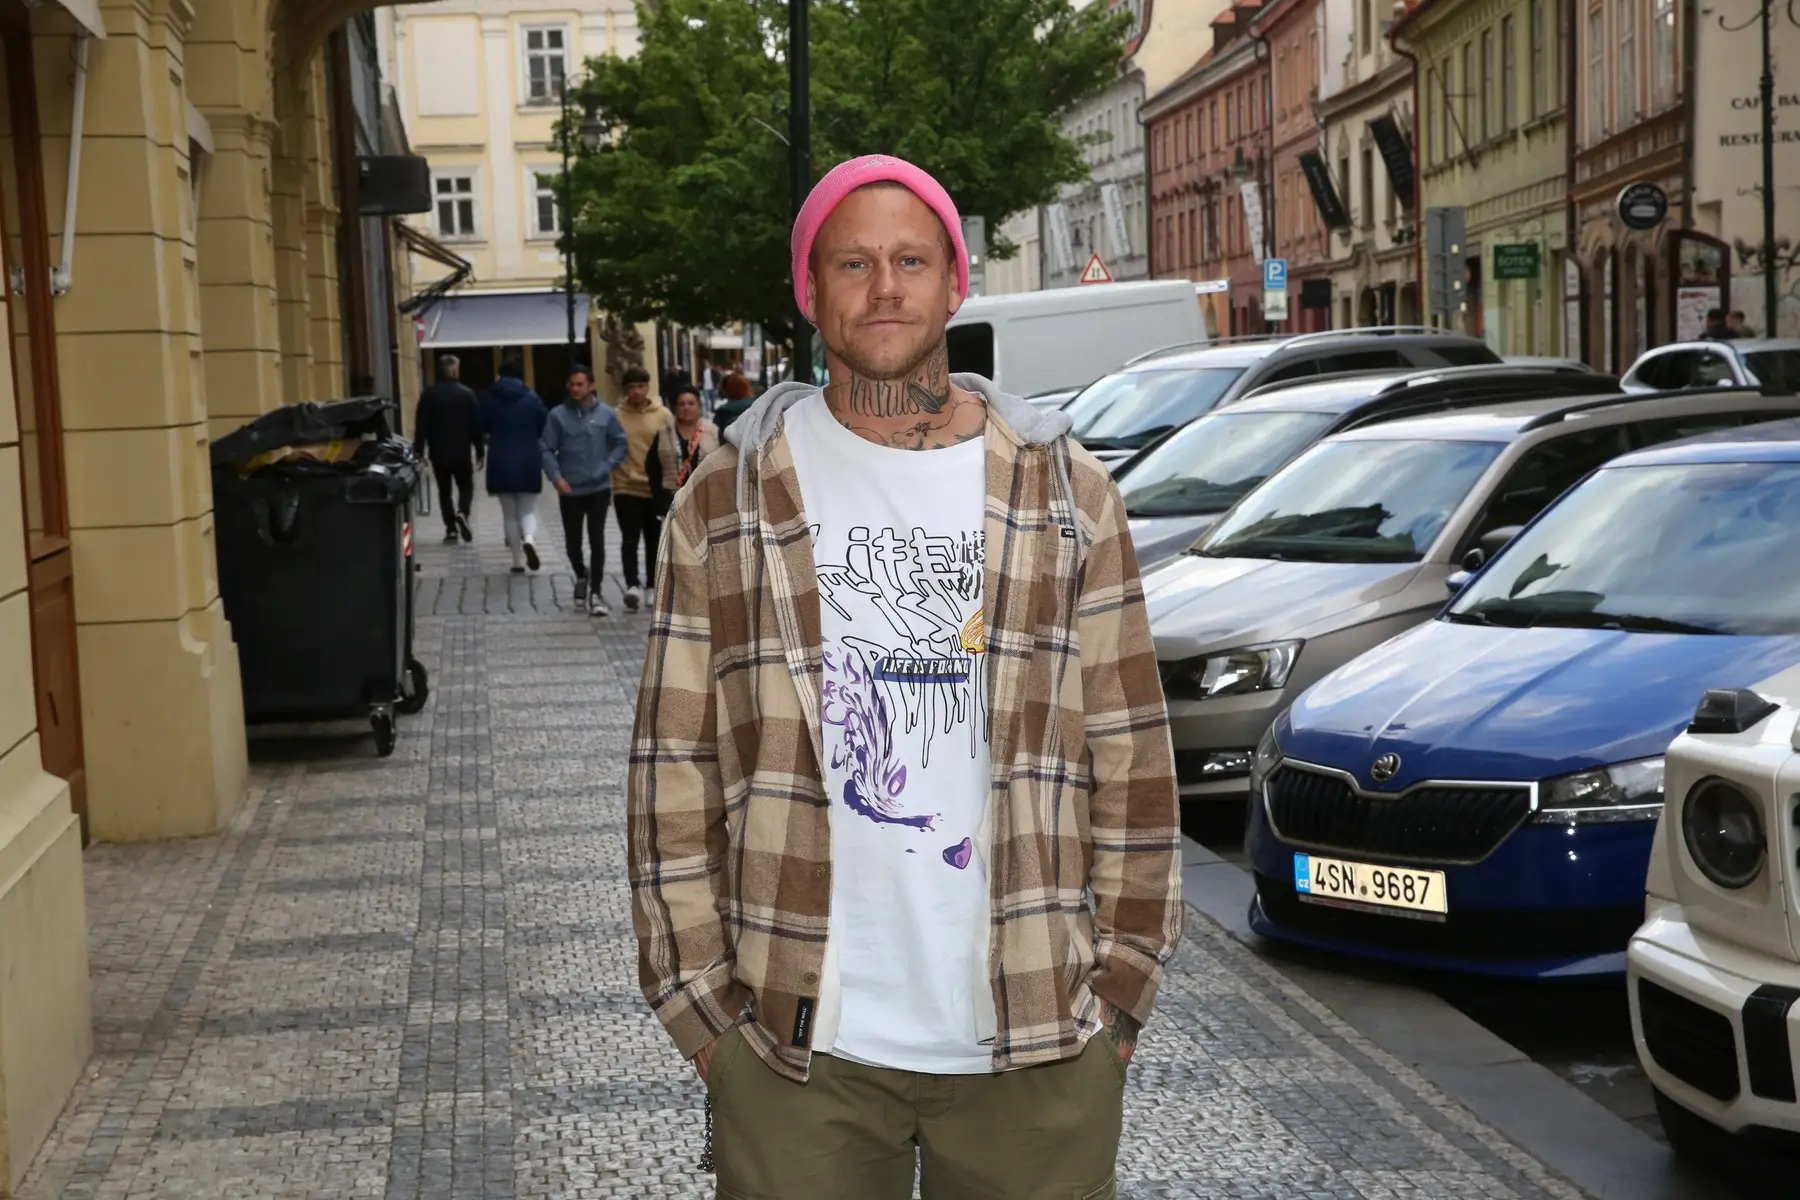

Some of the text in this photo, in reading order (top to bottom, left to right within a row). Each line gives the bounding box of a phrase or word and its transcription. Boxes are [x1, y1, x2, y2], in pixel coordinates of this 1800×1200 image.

[1731, 97, 1765, 109] CAF
[1269, 263, 1281, 280] P
[1299, 862, 1431, 905] CZ 4SN 9687
